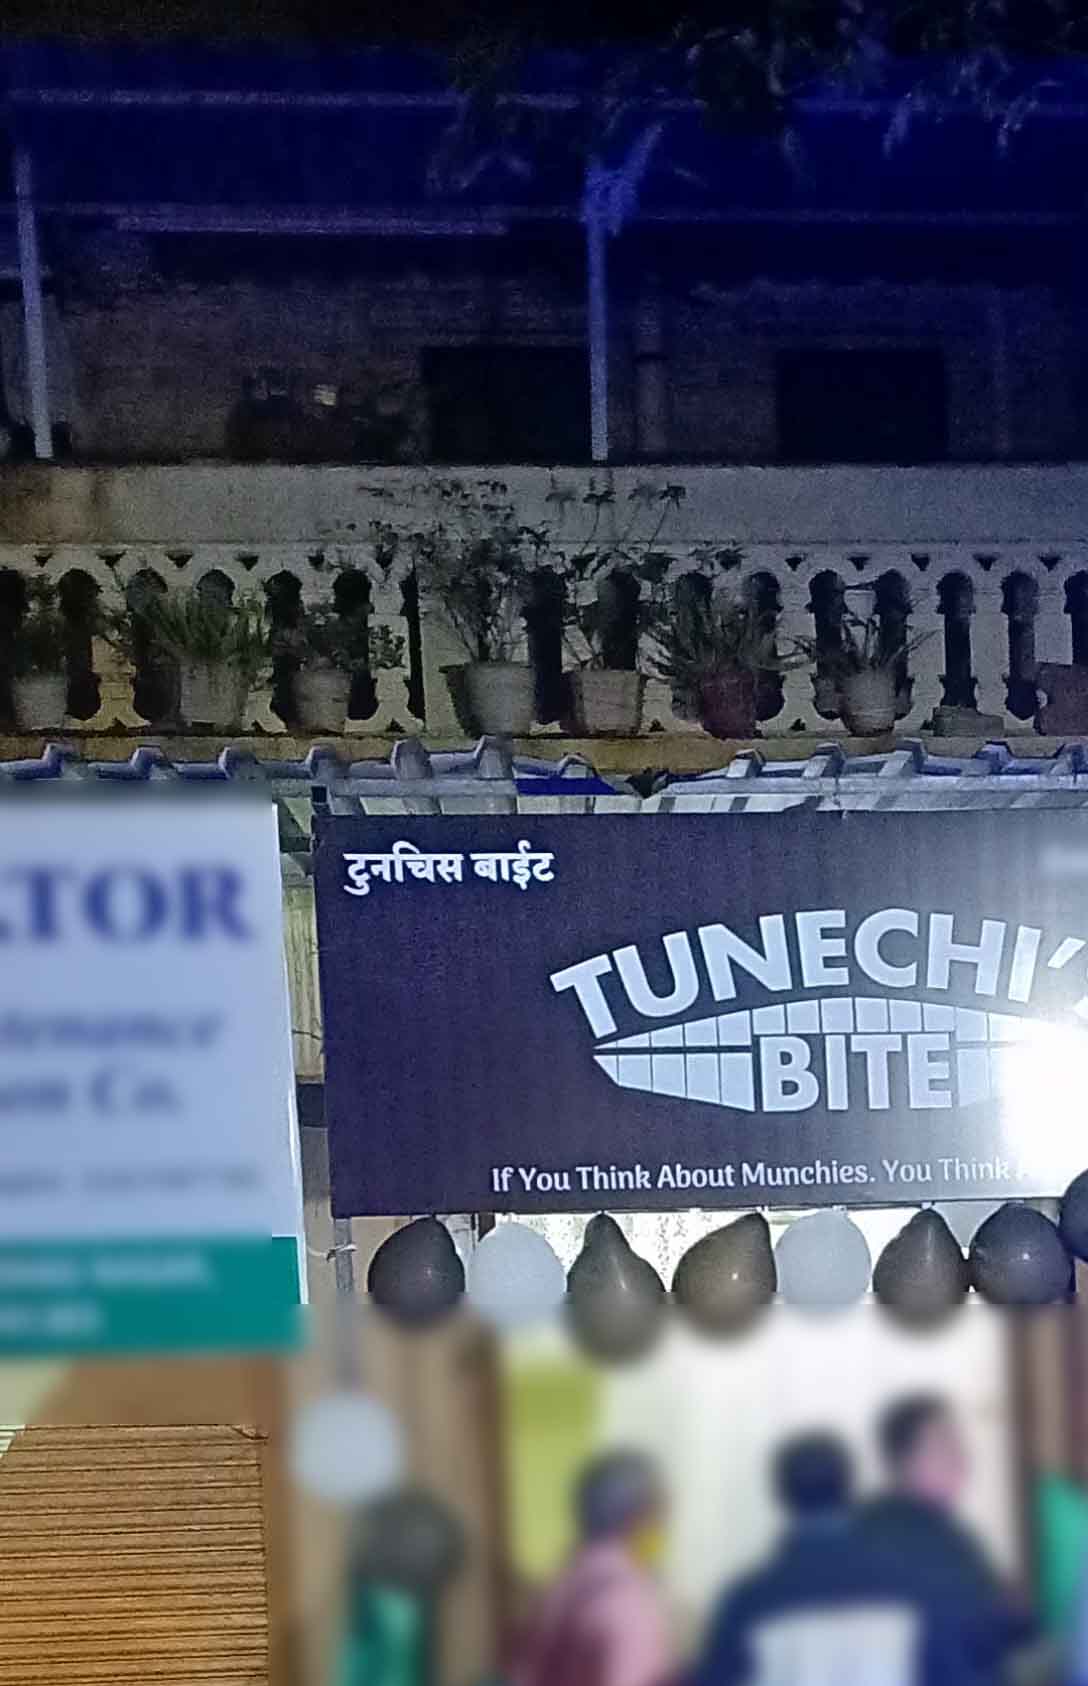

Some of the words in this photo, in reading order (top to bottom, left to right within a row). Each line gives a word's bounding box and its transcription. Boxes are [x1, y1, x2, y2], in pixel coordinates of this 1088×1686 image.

[342, 840, 464, 896] टुनचिस
[469, 839, 555, 891] बाईट
[762, 1034, 953, 1113] BITE
[492, 1166, 514, 1192] If
[518, 1167, 571, 1192] You
[575, 1164, 652, 1190] Think
[656, 1164, 735, 1189] About
[741, 1160, 876, 1188] Munchies.
[882, 1158, 932, 1183] You
[938, 1157, 1010, 1181] Think
